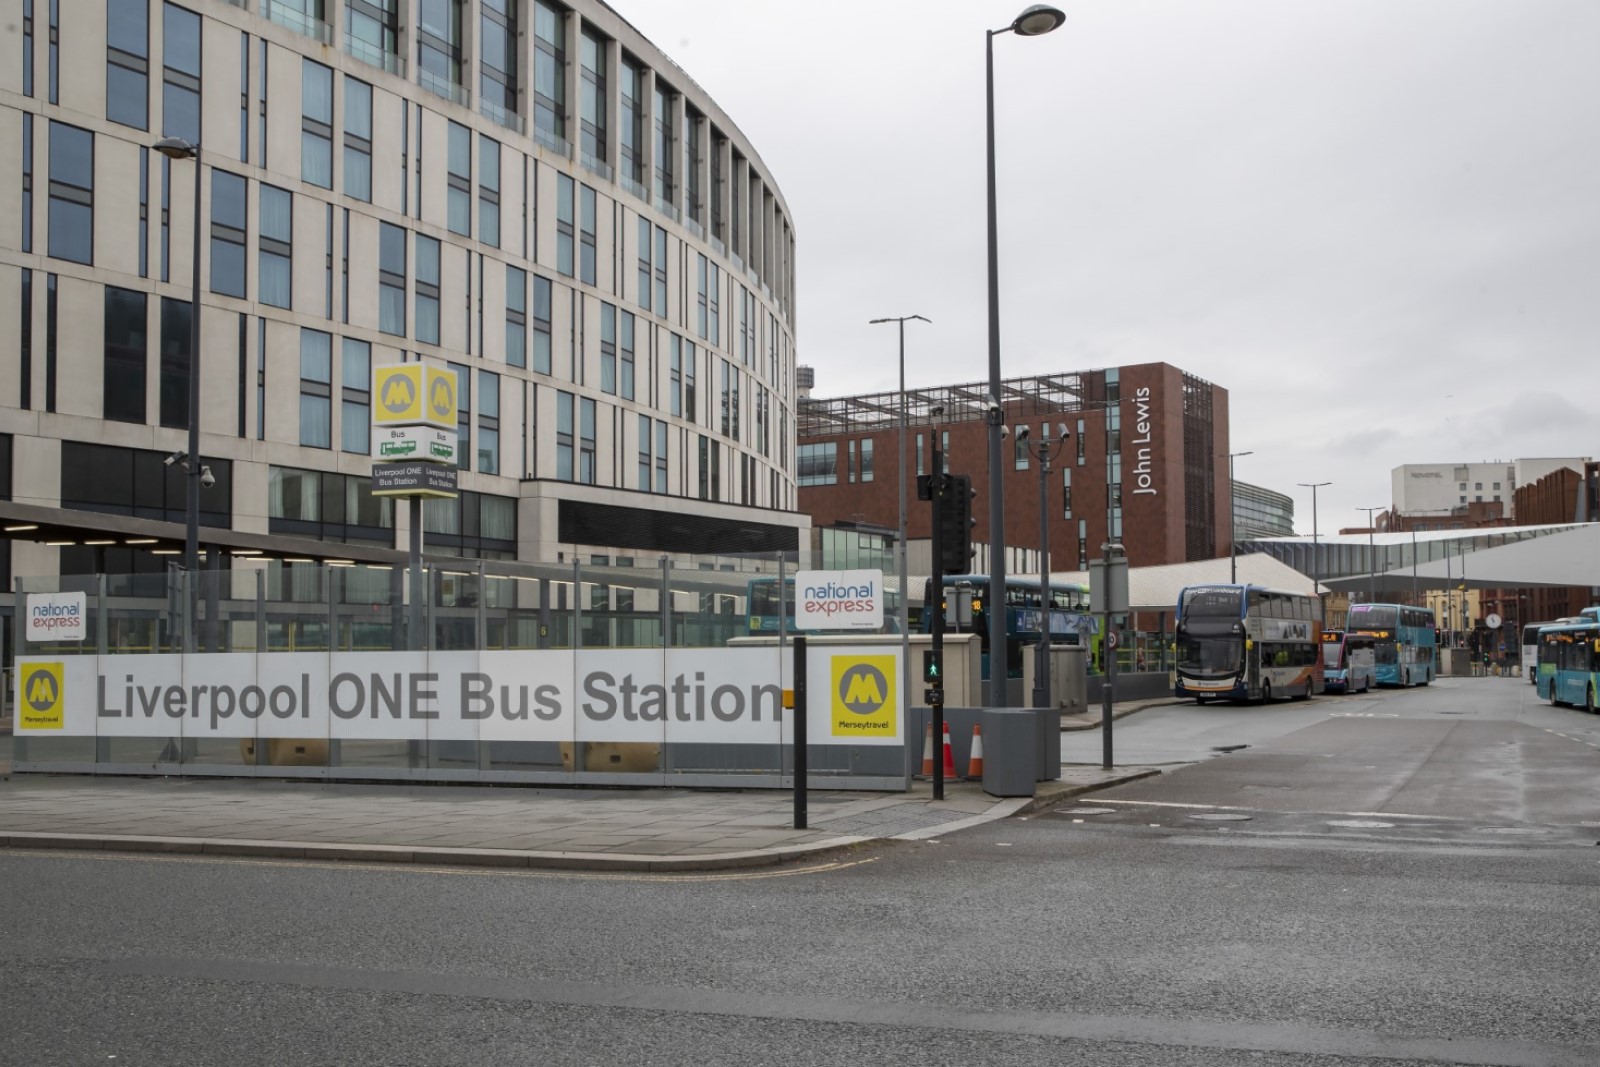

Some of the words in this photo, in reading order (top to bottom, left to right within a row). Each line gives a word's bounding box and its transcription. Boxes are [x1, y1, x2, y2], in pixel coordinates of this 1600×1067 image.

[1131, 387, 1151, 444] Lewis
[390, 430, 406, 439] Bus
[436, 432, 446, 441] Bus
[374, 467, 405, 477] Liverpool
[406, 466, 422, 475] ONE
[425, 466, 446, 477] Liverpool
[446, 471, 457, 480] ONE
[1132, 447, 1157, 495] John
[379, 478, 393, 486] Bus
[394, 477, 418, 485] Station
[428, 477, 438, 486] Bus
[438, 478, 454, 488] Station
[804, 581, 873, 599] national
[33, 601, 80, 617] national
[804, 599, 874, 617] express
[33, 616, 81, 631] express
[97, 673, 310, 730] Liverpool
[329, 672, 440, 720] ONE
[460, 672, 563, 721] Bus
[581, 671, 782, 722] Station
[838, 720, 889, 730] Merseytravel
